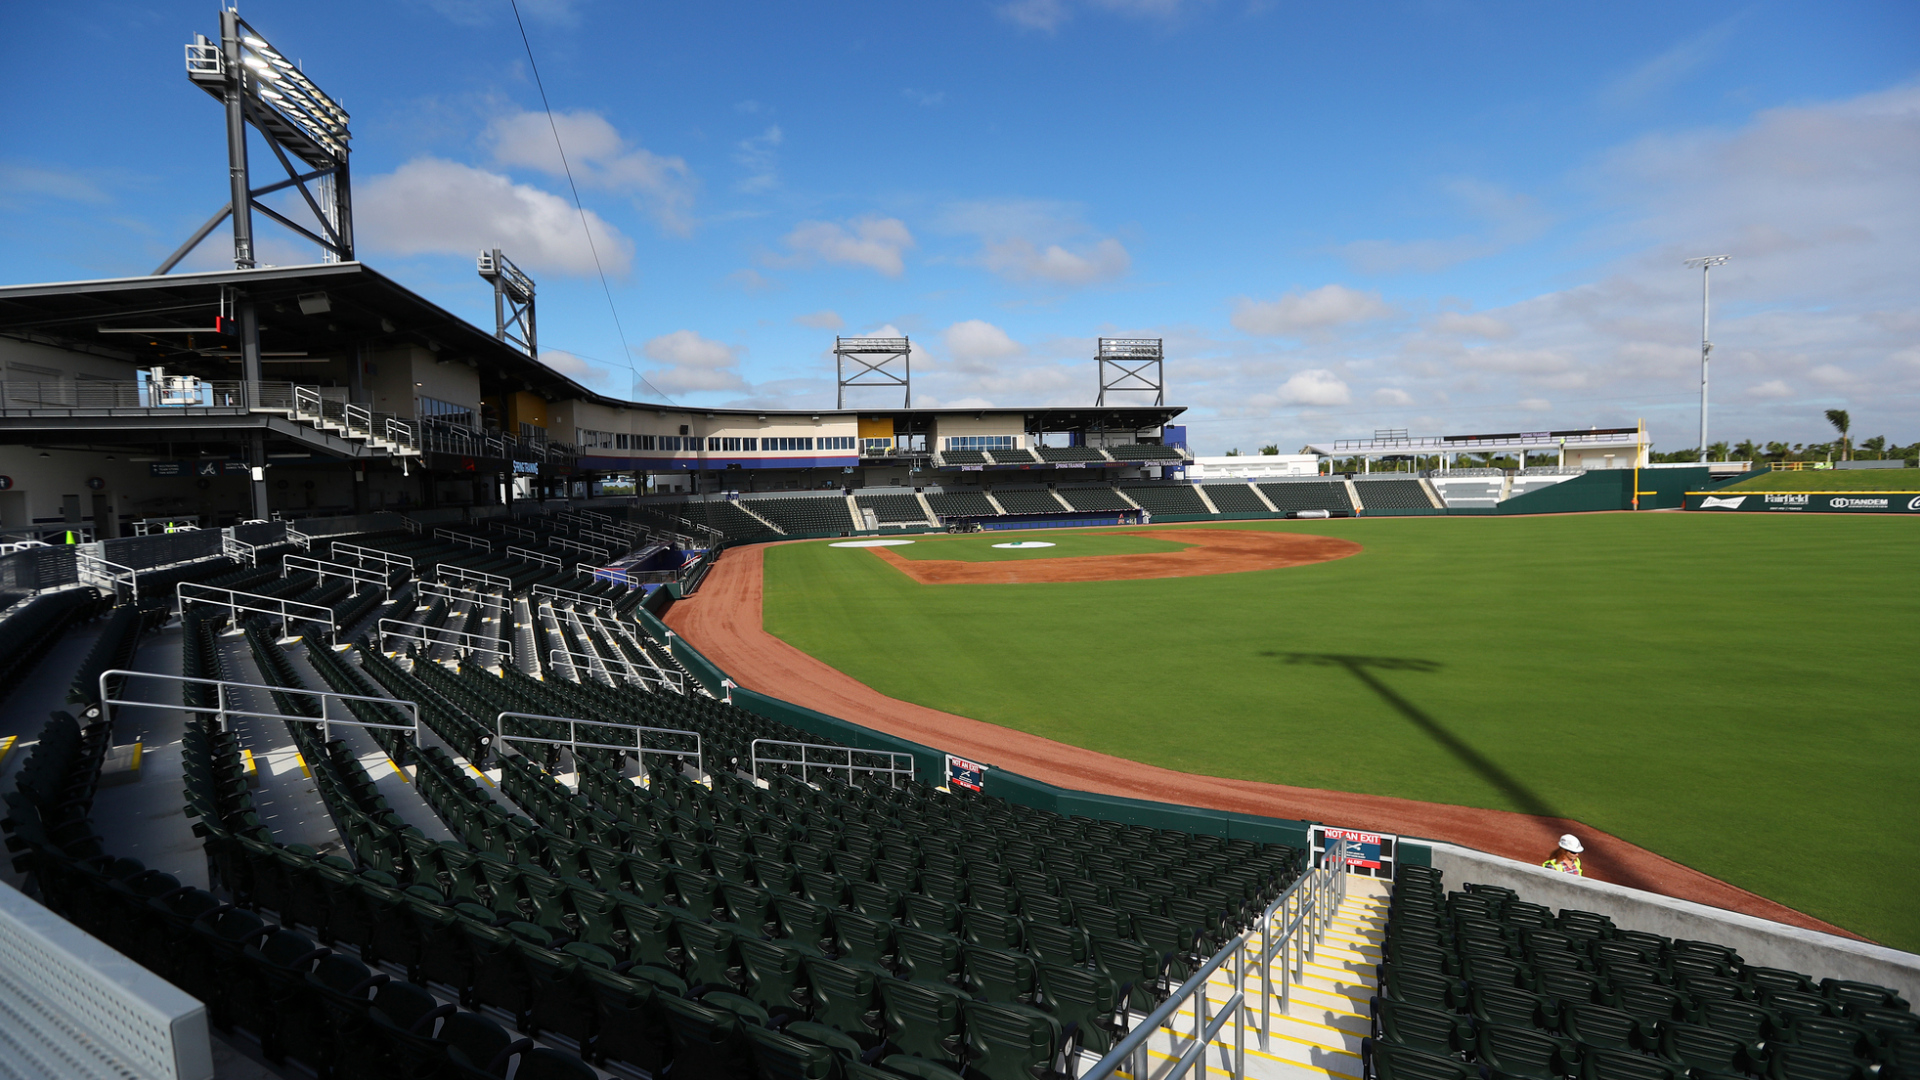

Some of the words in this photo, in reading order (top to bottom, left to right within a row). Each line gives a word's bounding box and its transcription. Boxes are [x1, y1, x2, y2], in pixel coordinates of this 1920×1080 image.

[952, 758, 961, 767] NOT
[961, 760, 969, 769] AN
[969, 763, 979, 772] EXIT
[1325, 829, 1343, 839] NOT
[1345, 832, 1358, 841] AN
[1360, 834, 1379, 844] EXIT
